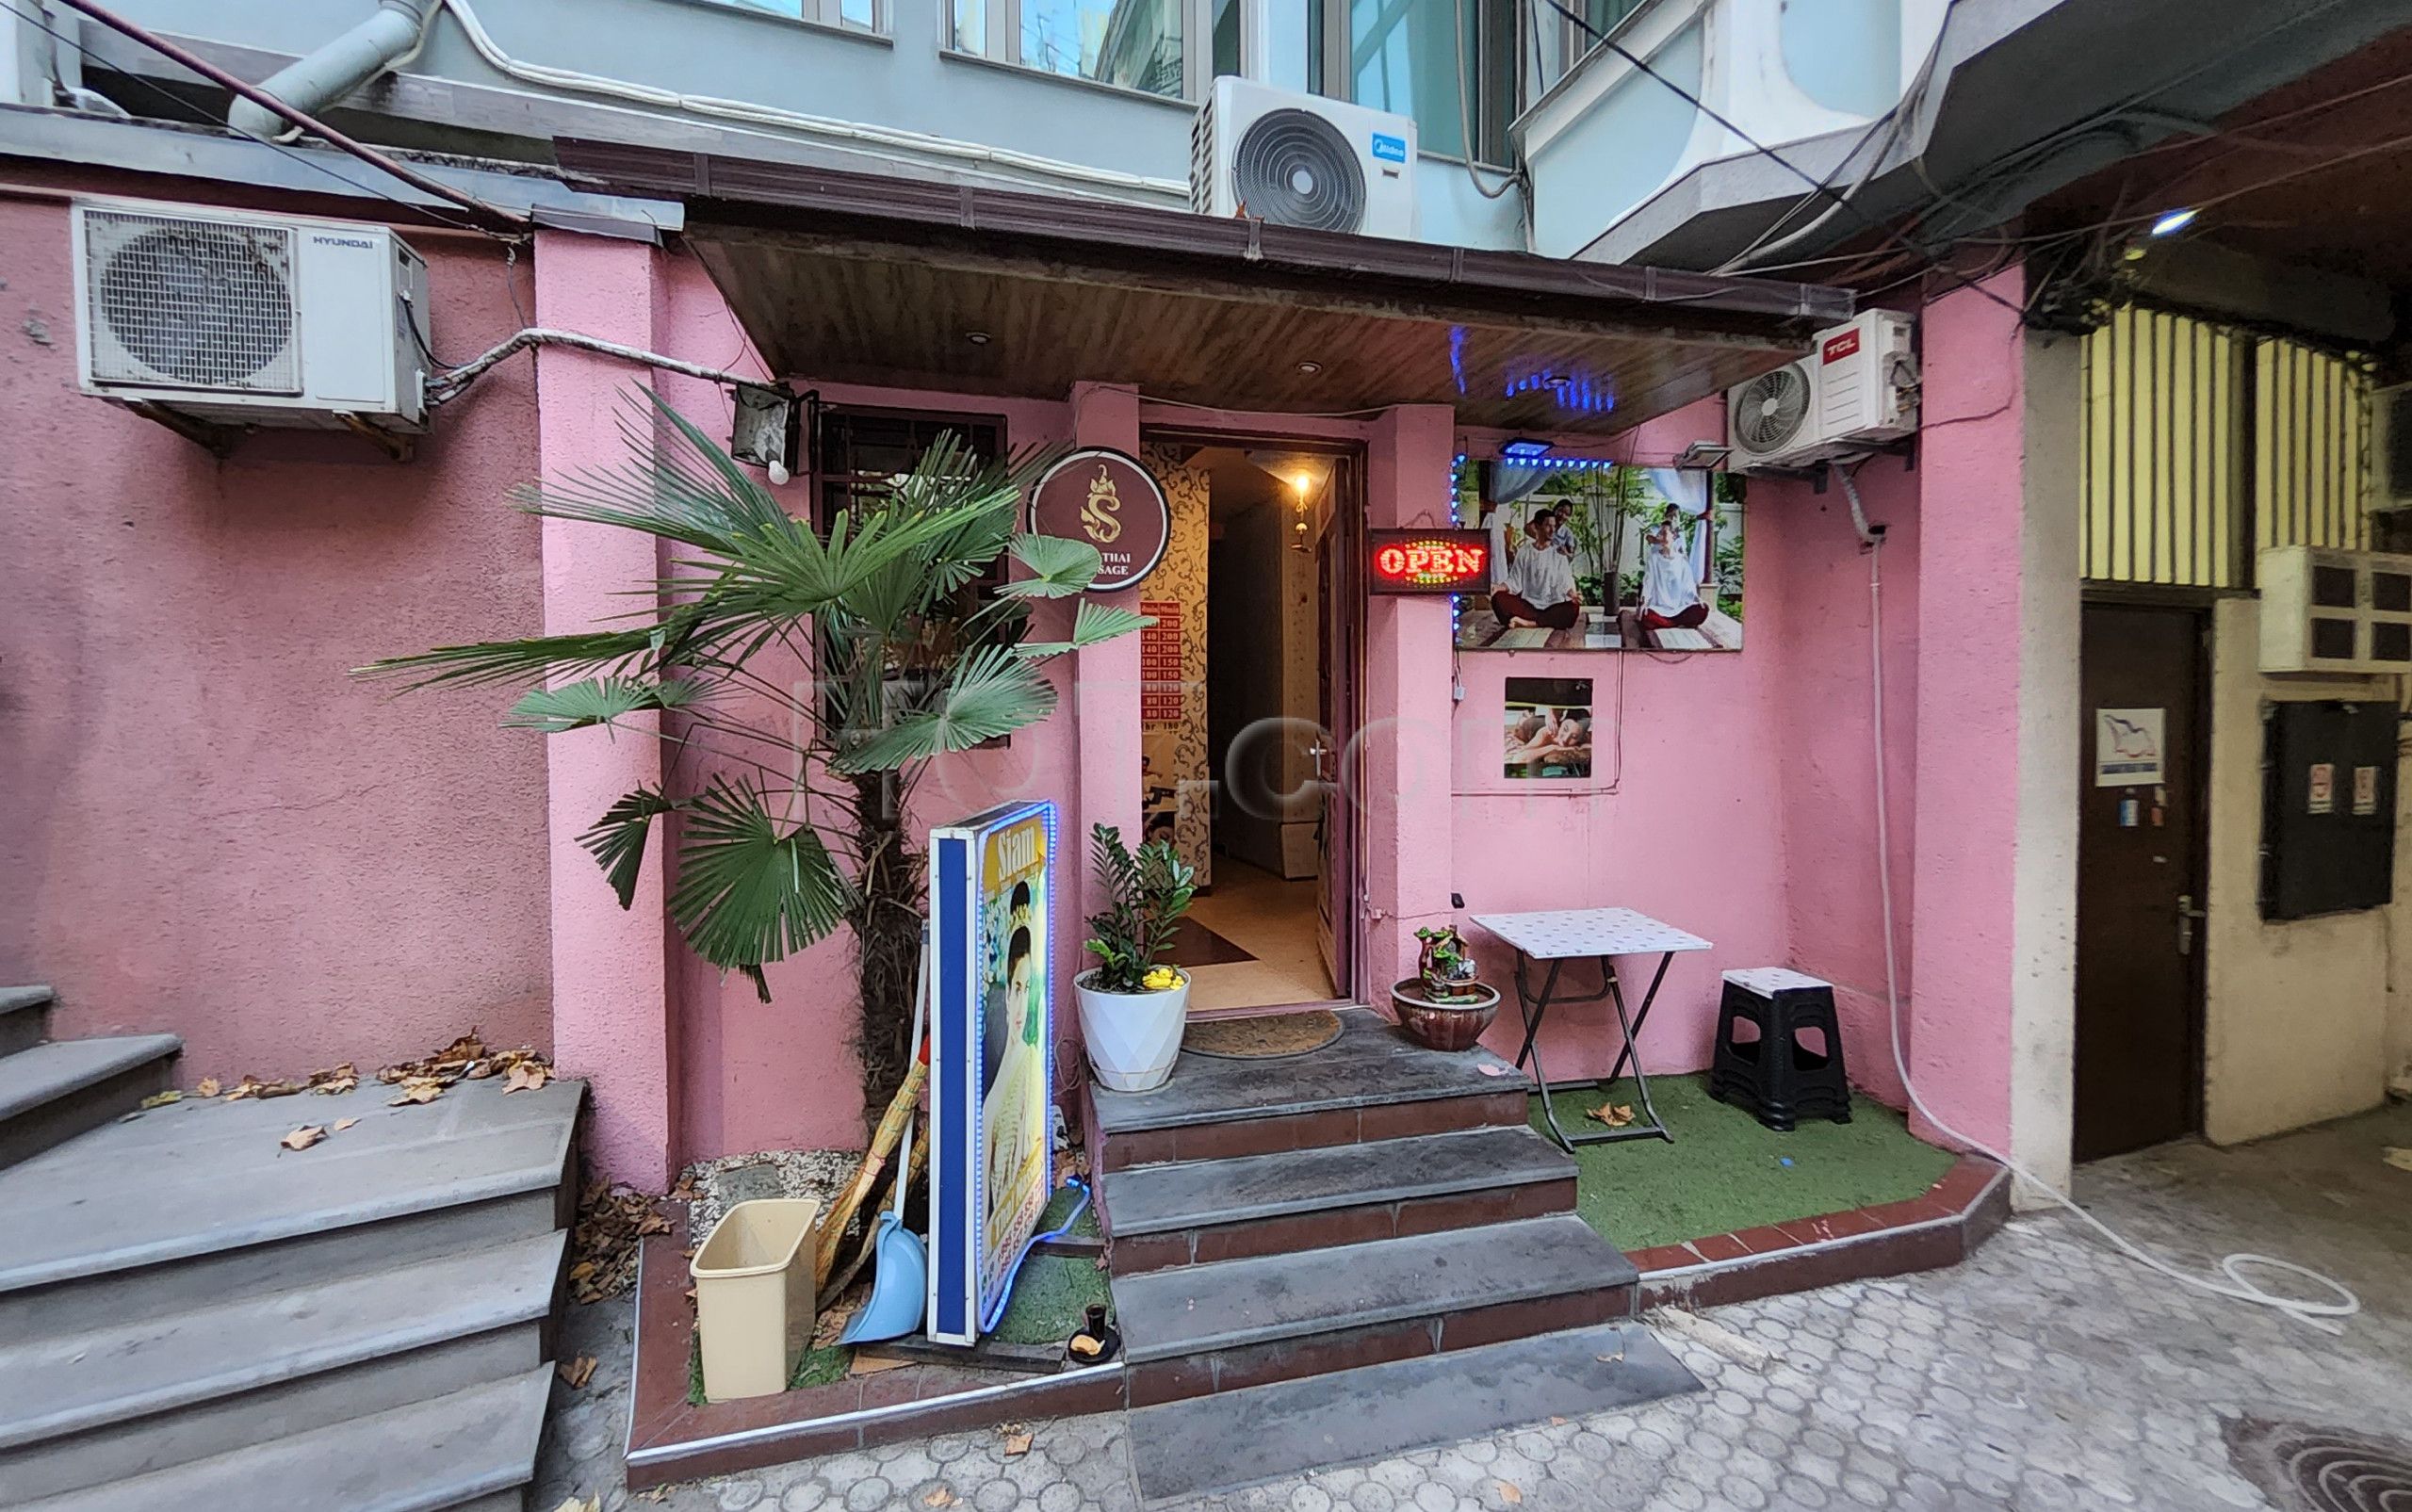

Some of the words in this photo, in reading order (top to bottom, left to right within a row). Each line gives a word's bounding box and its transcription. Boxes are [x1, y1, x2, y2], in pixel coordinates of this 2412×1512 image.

[313, 236, 373, 249] HYUNDAI
[1827, 338, 1856, 356] TCL
[1101, 552, 1131, 563] THAI
[1379, 547, 1485, 574] OPEN
[1097, 565, 1129, 576] SAGE
[1163, 658, 1179, 667] 150
[1163, 671, 1180, 679] 150
[998, 825, 1035, 883] Siam
